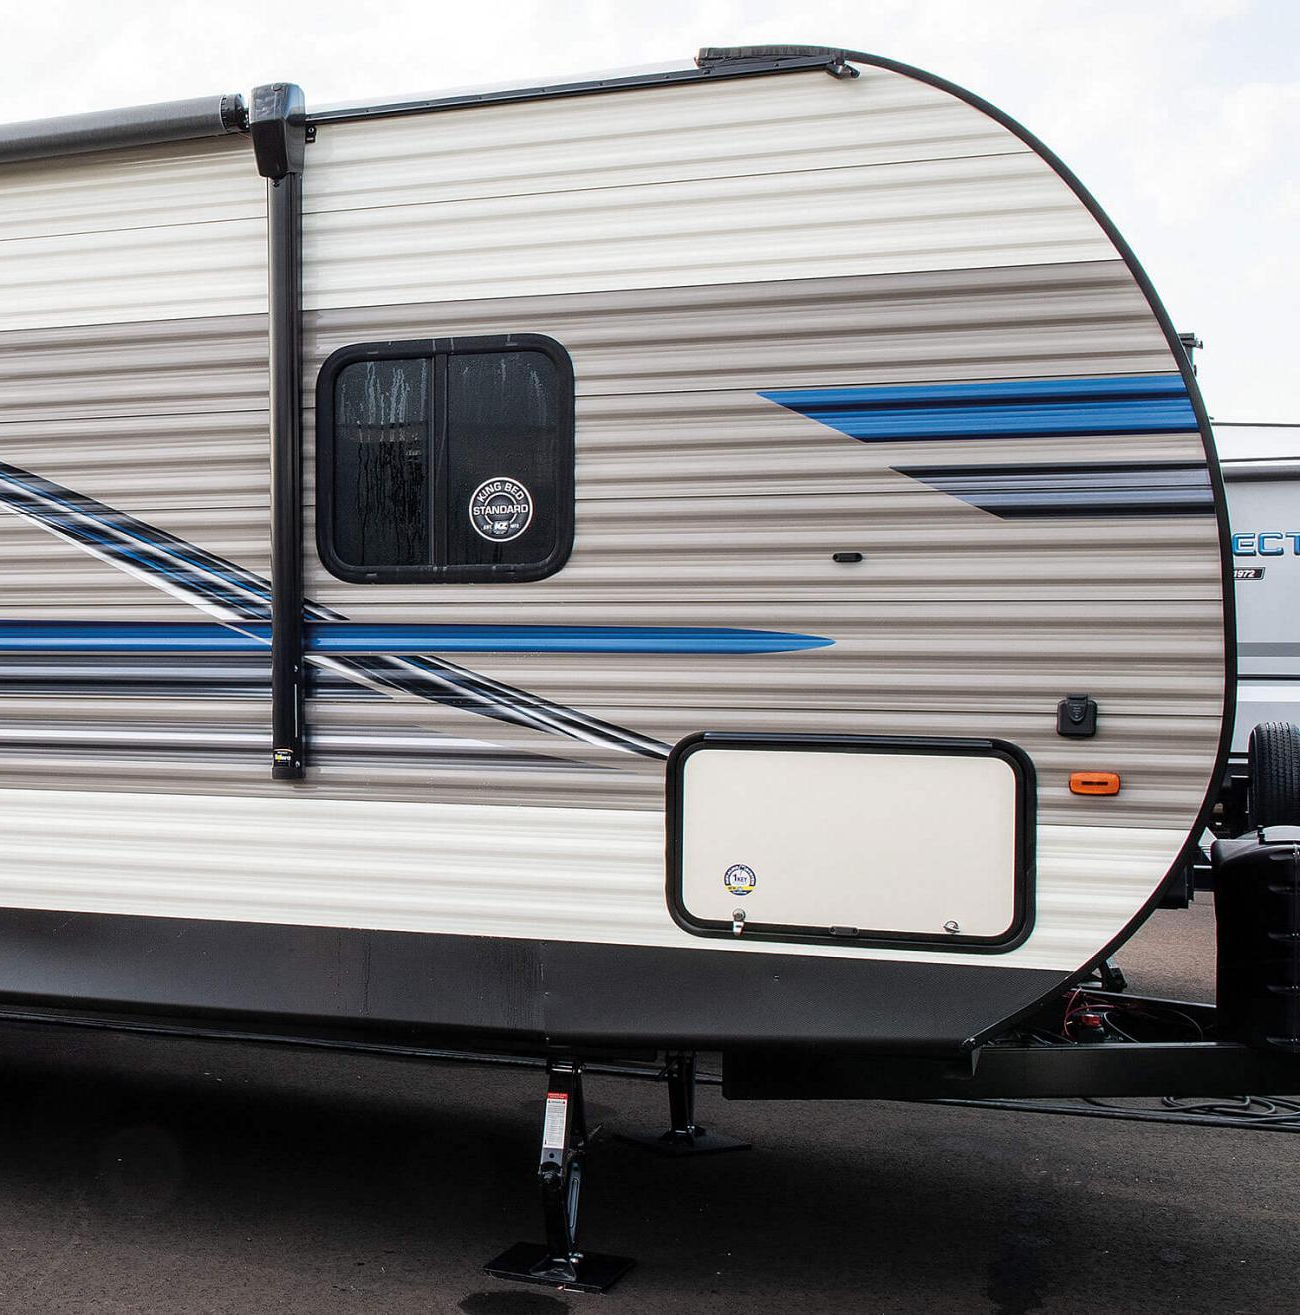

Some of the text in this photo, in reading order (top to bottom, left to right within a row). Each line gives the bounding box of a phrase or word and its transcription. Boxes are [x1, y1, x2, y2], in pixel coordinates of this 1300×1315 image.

[477, 482, 525, 502] KING BED
[473, 504, 529, 516] STANDARD
